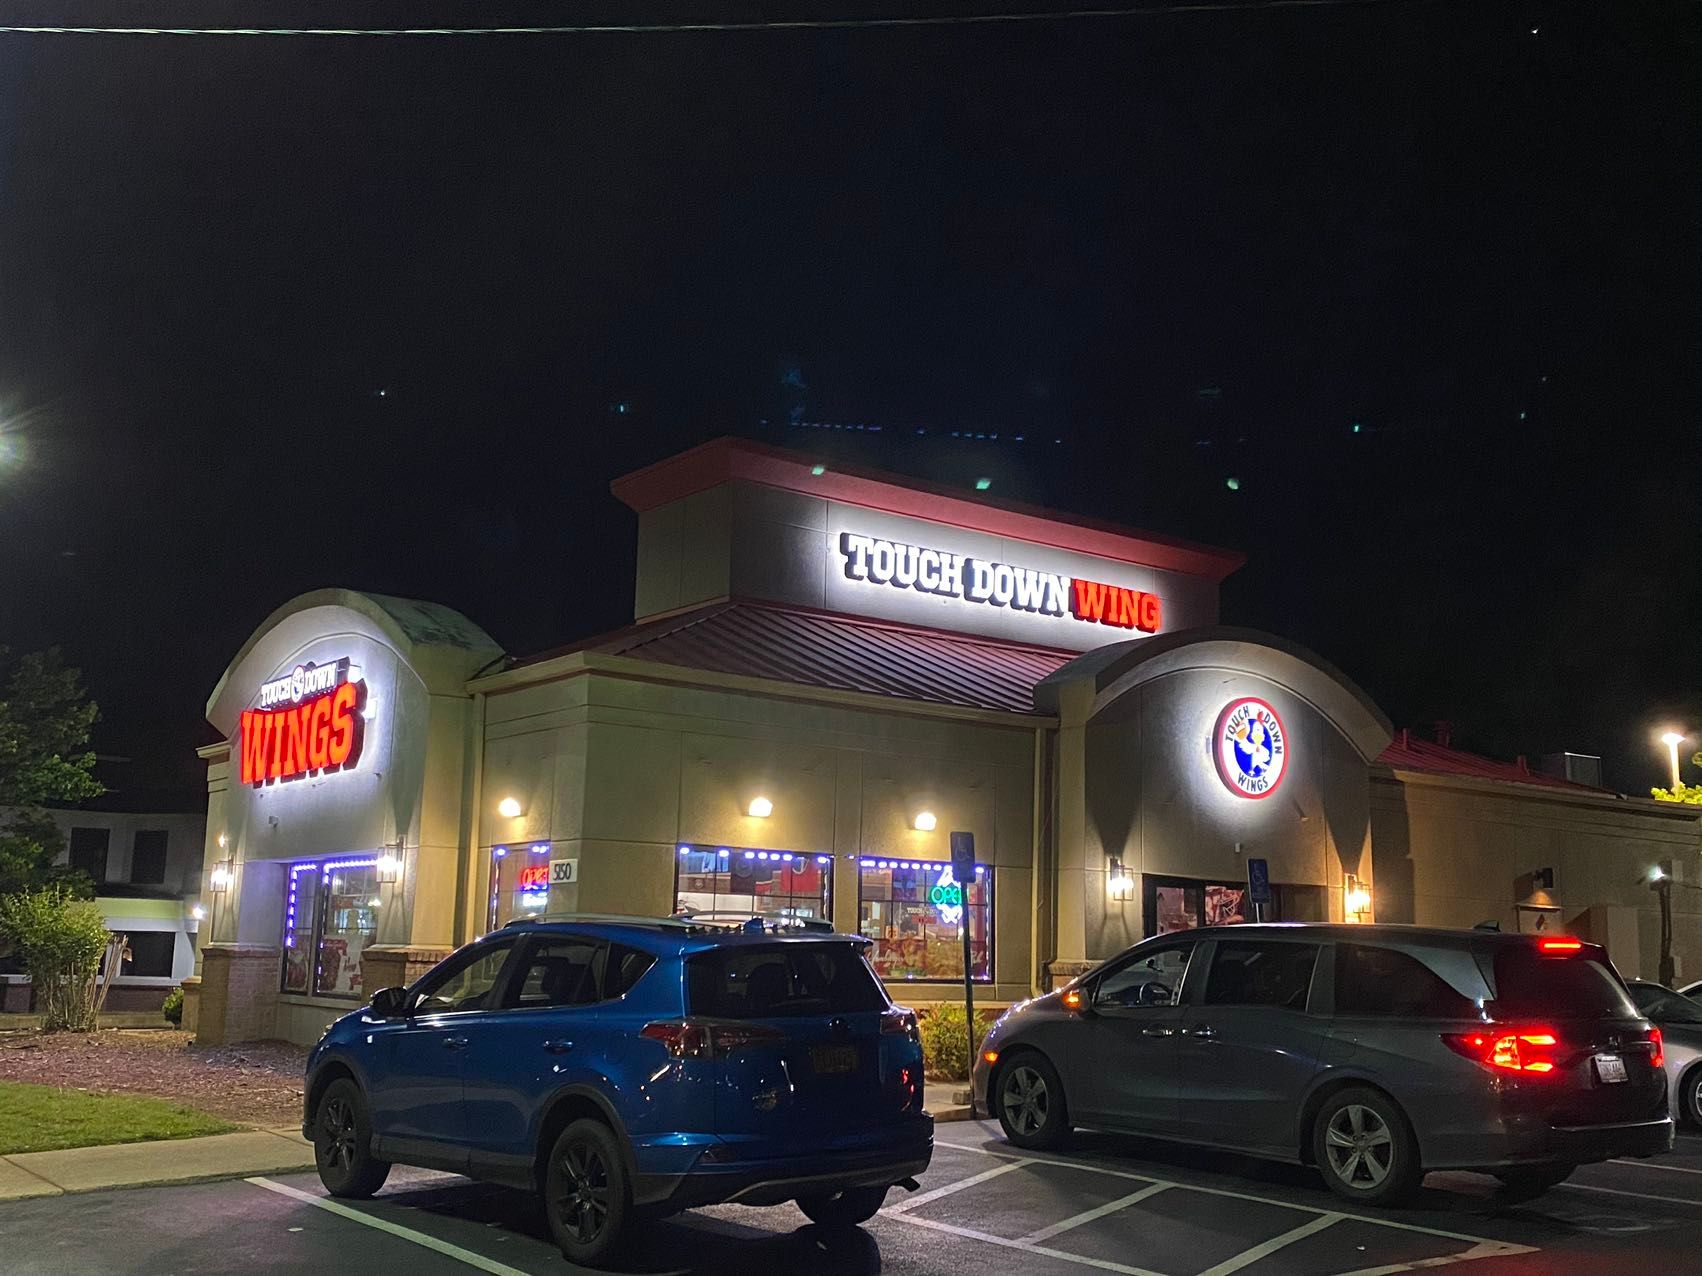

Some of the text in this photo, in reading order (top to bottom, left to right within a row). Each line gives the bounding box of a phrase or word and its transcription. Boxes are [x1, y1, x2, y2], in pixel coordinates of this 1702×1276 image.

[844, 533, 1162, 631] TOUCH DOWN WING
[261, 662, 338, 707] TOUCH DOWN
[241, 682, 357, 785] WINGS
[1225, 705, 1283, 754] TOUCH DOWN
[1237, 772, 1269, 792] WINGS
